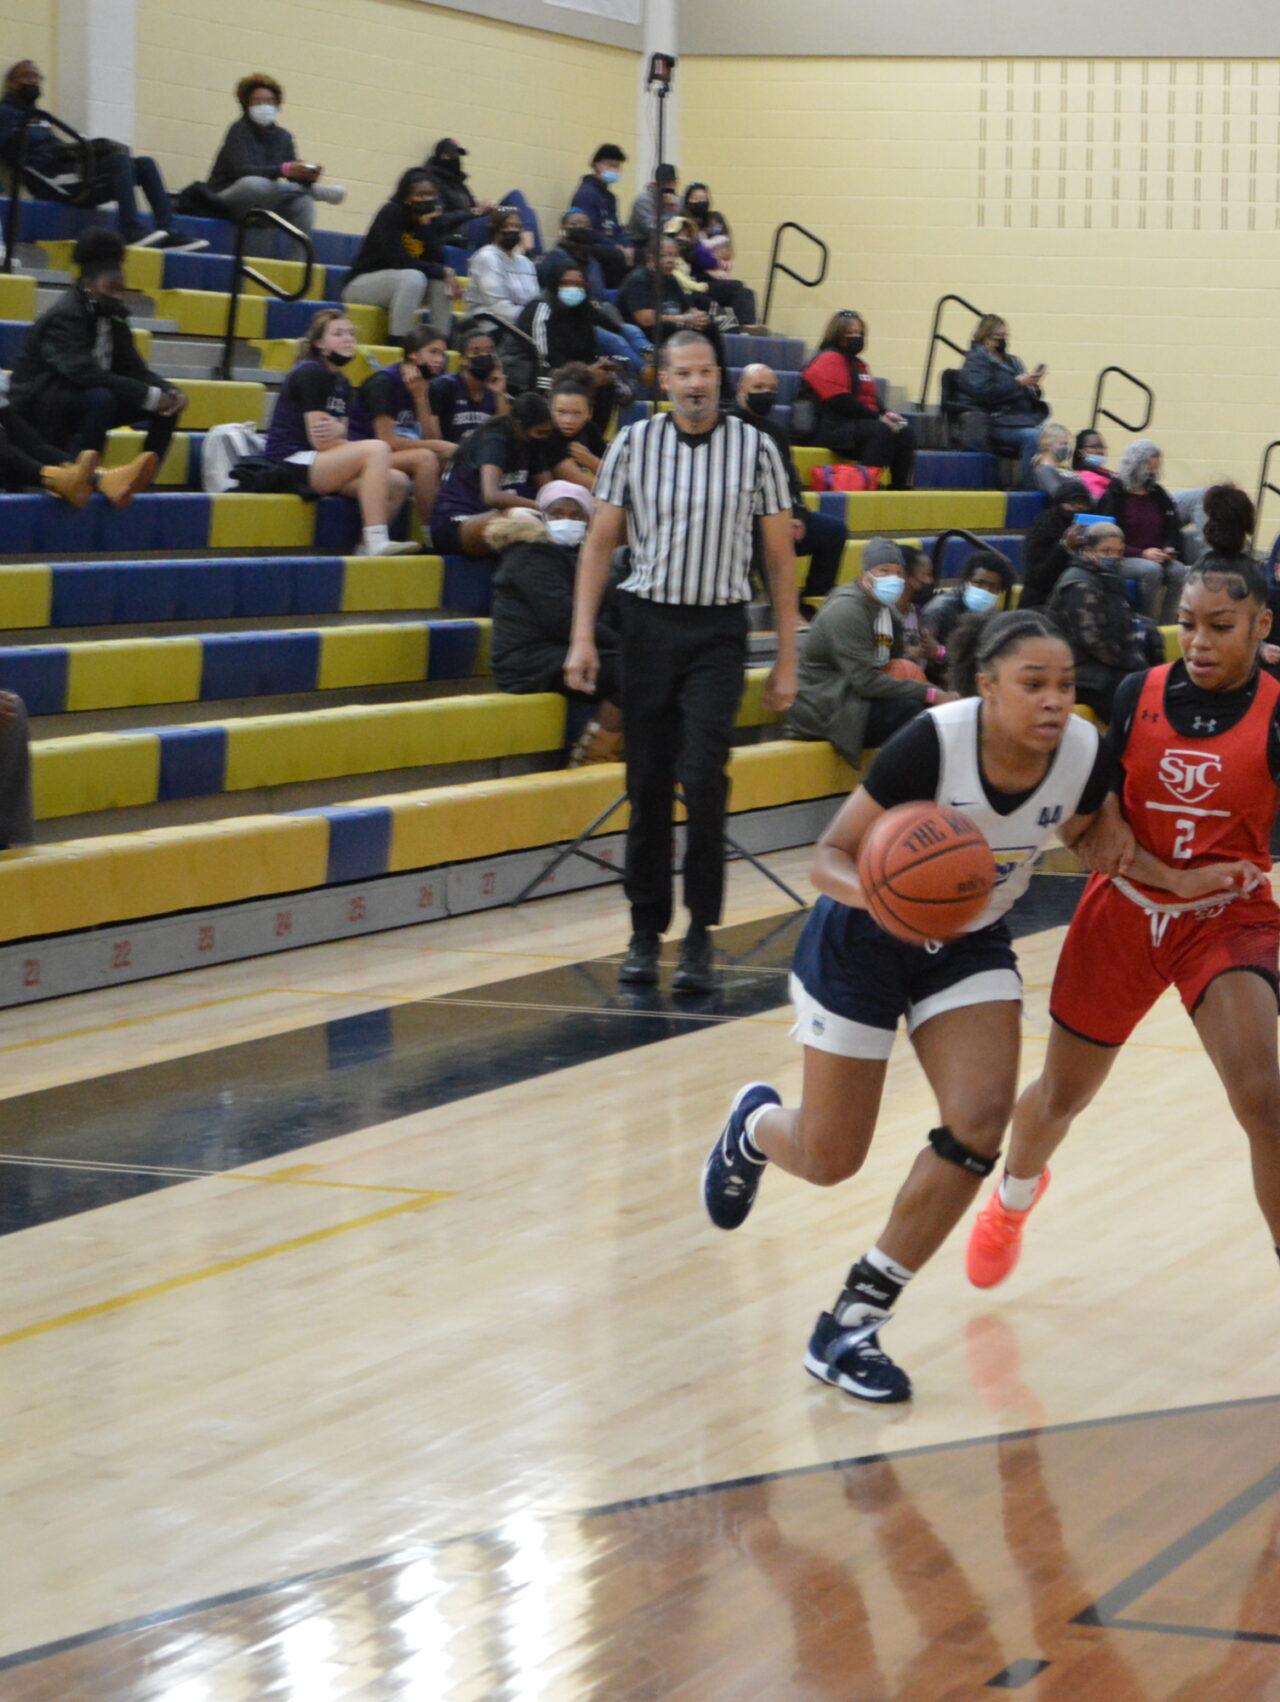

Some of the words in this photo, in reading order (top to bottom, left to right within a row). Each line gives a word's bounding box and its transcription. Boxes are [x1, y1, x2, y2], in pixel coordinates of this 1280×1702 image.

[1158, 757, 1221, 793] SJC
[1038, 805, 1062, 827] 44
[904, 819, 947, 853] THE
[1173, 819, 1195, 859] 2
